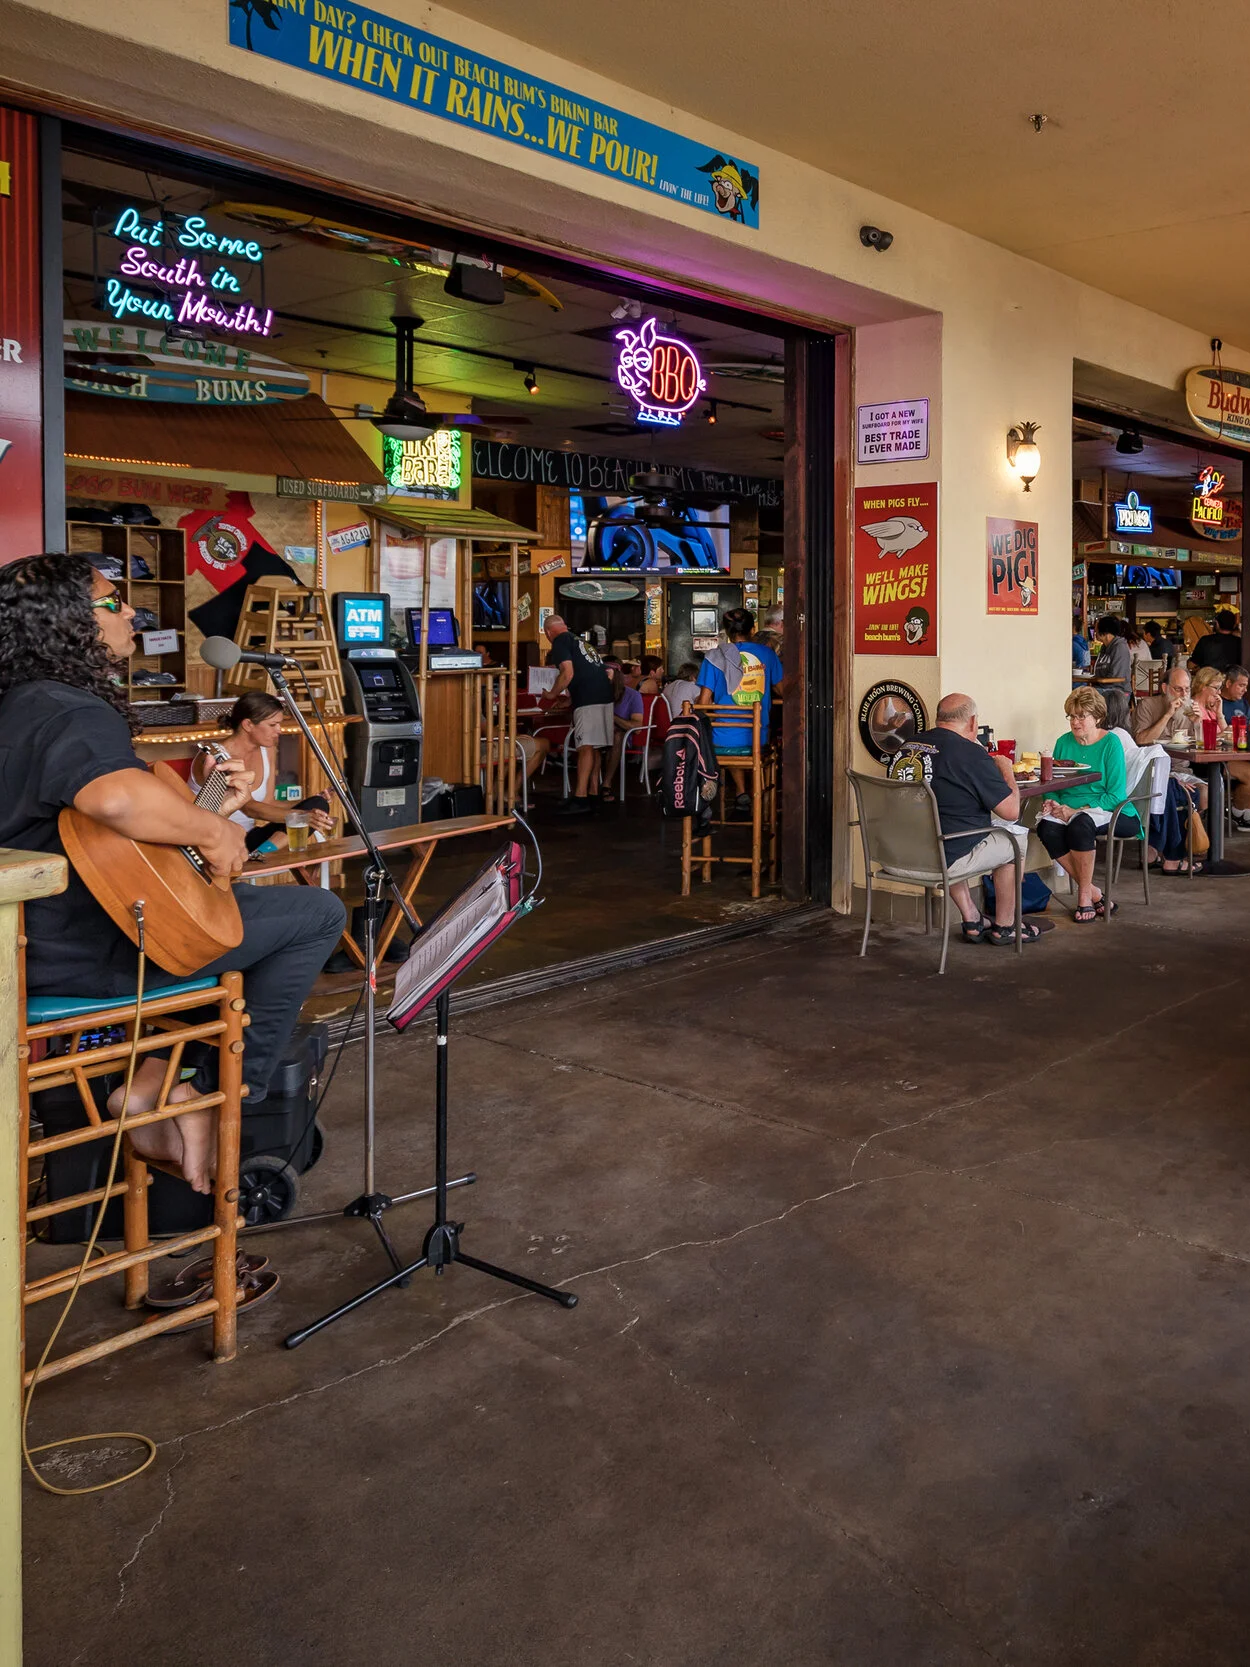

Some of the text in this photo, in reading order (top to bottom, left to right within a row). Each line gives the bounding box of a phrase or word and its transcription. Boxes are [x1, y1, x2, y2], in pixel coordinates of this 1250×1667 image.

[314, 0, 357, 34] DAY?
[361, 19, 414, 58] CHECK
[418, 42, 450, 71] OUT
[454, 56, 500, 92] BEACH
[503, 74, 547, 109] BUM'S
[550, 94, 591, 126] BIKINI
[592, 110, 619, 137] BAR
[308, 24, 402, 93] WHEN
[408, 63, 440, 105] IT
[589, 131, 660, 186] POUR!
[658, 179, 710, 207] LIVIN' THE LIFE!
[114, 208, 263, 262] Put Some
[120, 246, 241, 293] South in
[107, 278, 274, 336] Your Mouth!
[72, 326, 252, 373] WELCOME
[652, 346, 696, 403] BBQ
[195, 379, 267, 402] BUMS
[862, 421, 891, 430] SURFBOARD
[870, 409, 916, 421] I GOT A NEW
[1226, 413, 1244, 425] KING
[864, 440, 921, 454] I EVER MADE
[865, 429, 920, 443] BEST TRADE
[472, 440, 558, 484] ELCOME
[562, 452, 583, 486] TO
[283, 479, 360, 500] USED SURFBOARDS
[863, 499, 886, 510] WHEN
[888, 498, 905, 509] PIGS
[990, 527, 1036, 556] WE DIG
[865, 564, 929, 585] WE'LL MAKE
[991, 550, 1036, 595] PIG!
[863, 577, 928, 606] WINGS!
[346, 608, 383, 622] ATM
[864, 632, 883, 641] beach
[860, 684, 924, 734] BLUE MOON BREWING COMPA
[673, 761, 686, 809] Reebok
